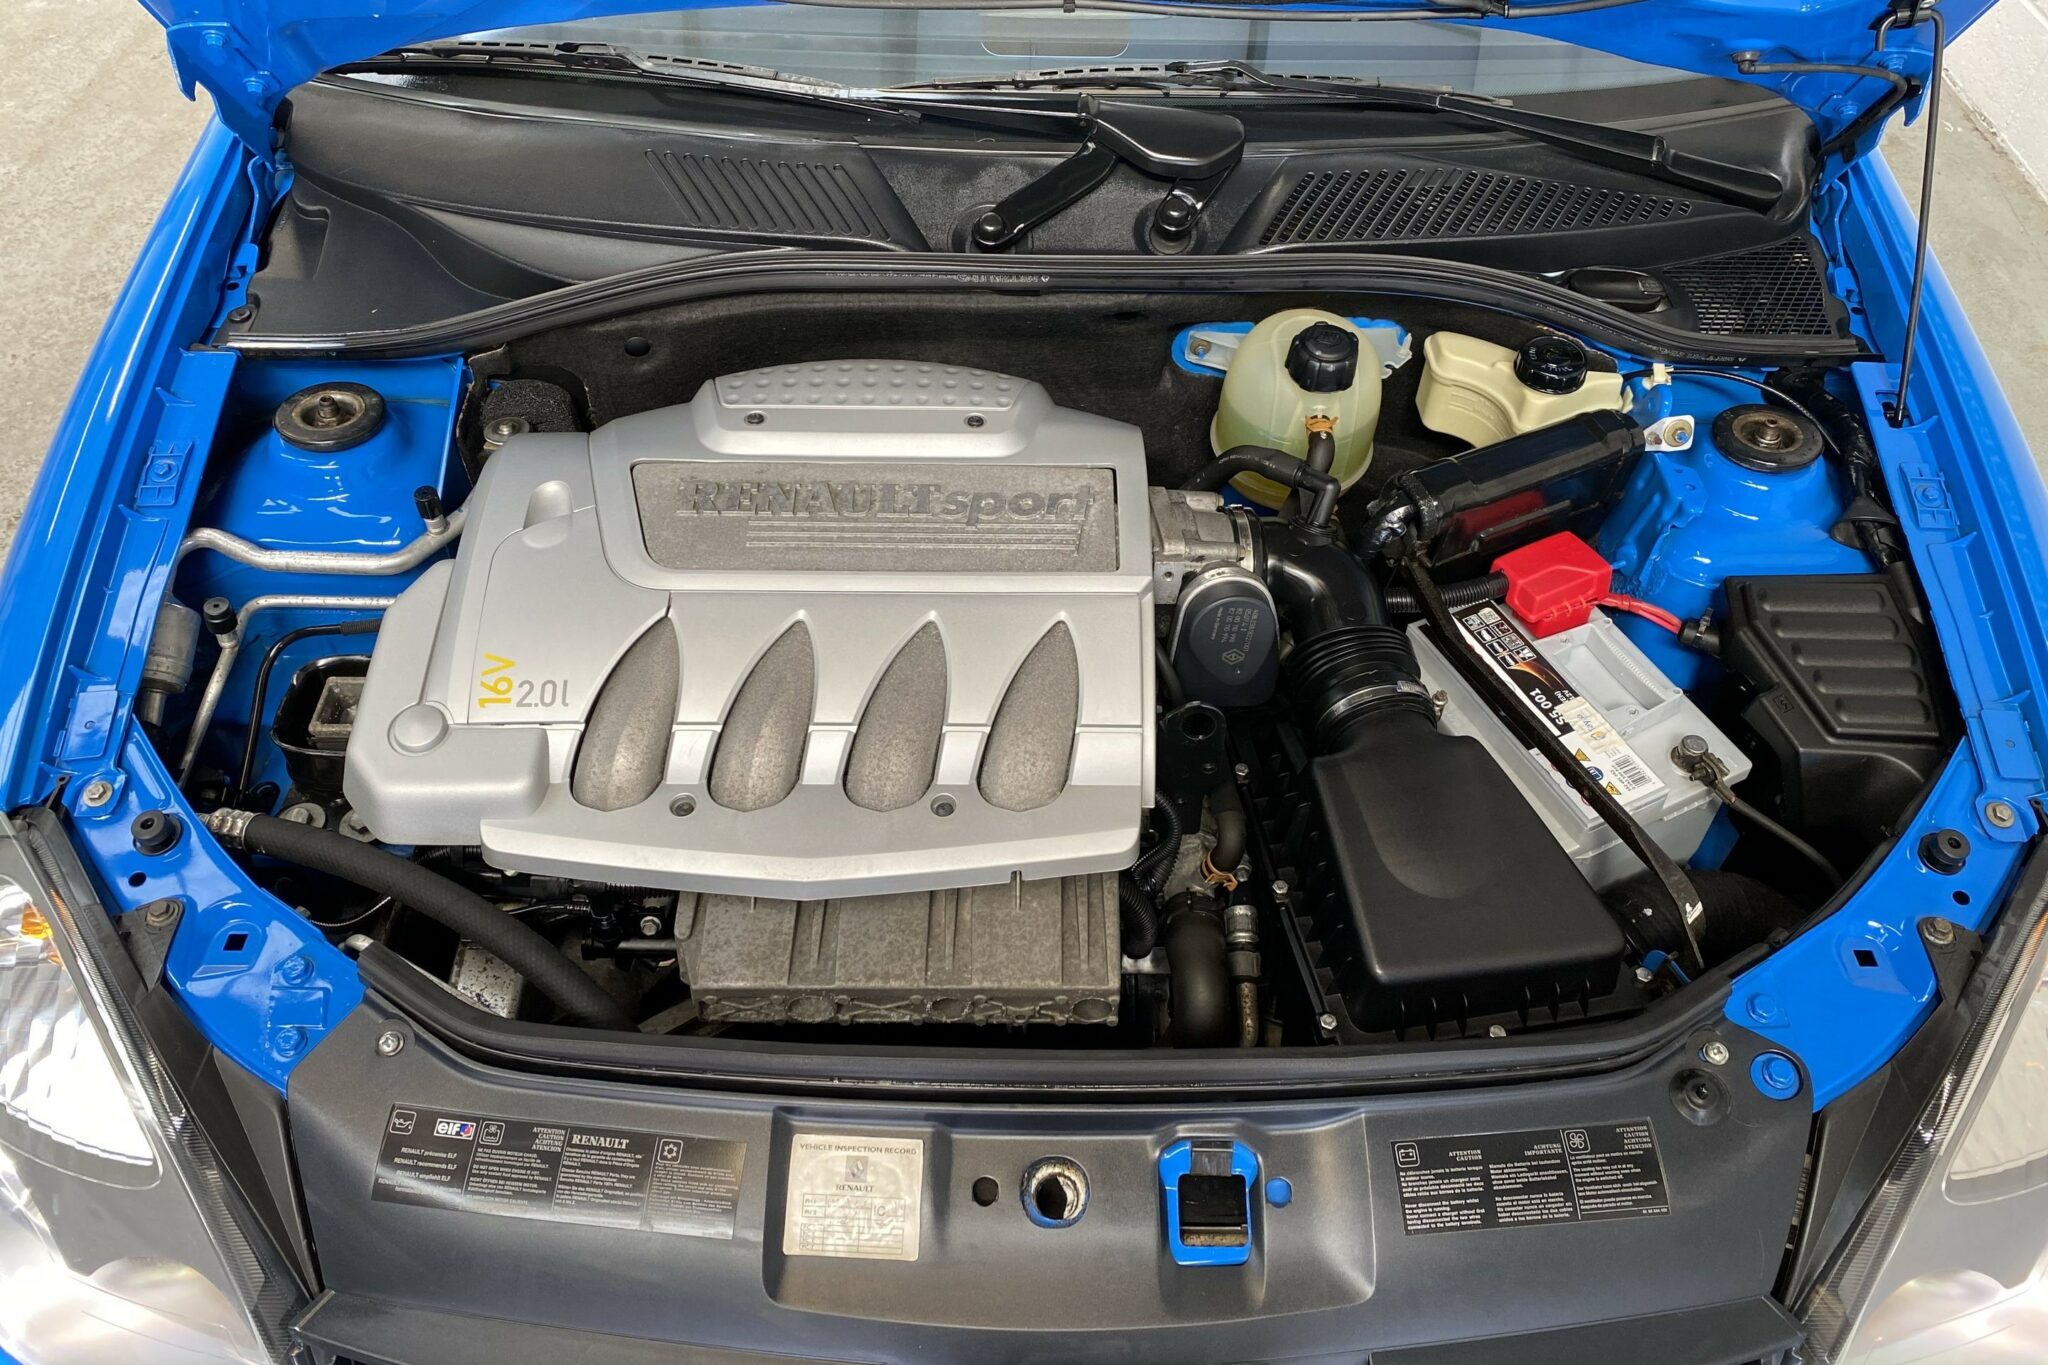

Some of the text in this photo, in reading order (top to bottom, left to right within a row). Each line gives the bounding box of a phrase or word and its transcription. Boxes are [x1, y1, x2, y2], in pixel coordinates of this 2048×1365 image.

[478, 653, 516, 709] 16V
[1529, 688, 1553, 710] 001
[437, 1121, 462, 1136] elf
[533, 1127, 565, 1136] ATTENTION
[535, 1139, 562, 1147] ACHTUNG
[571, 1134, 629, 1150] RENAULT
[401, 1147, 424, 1156] RENAULT
[800, 1144, 917, 1155] VEHICLE INSPECTION RECORD
[394, 1158, 418, 1166] RENAULT
[836, 1185, 874, 1193] RENAULT
